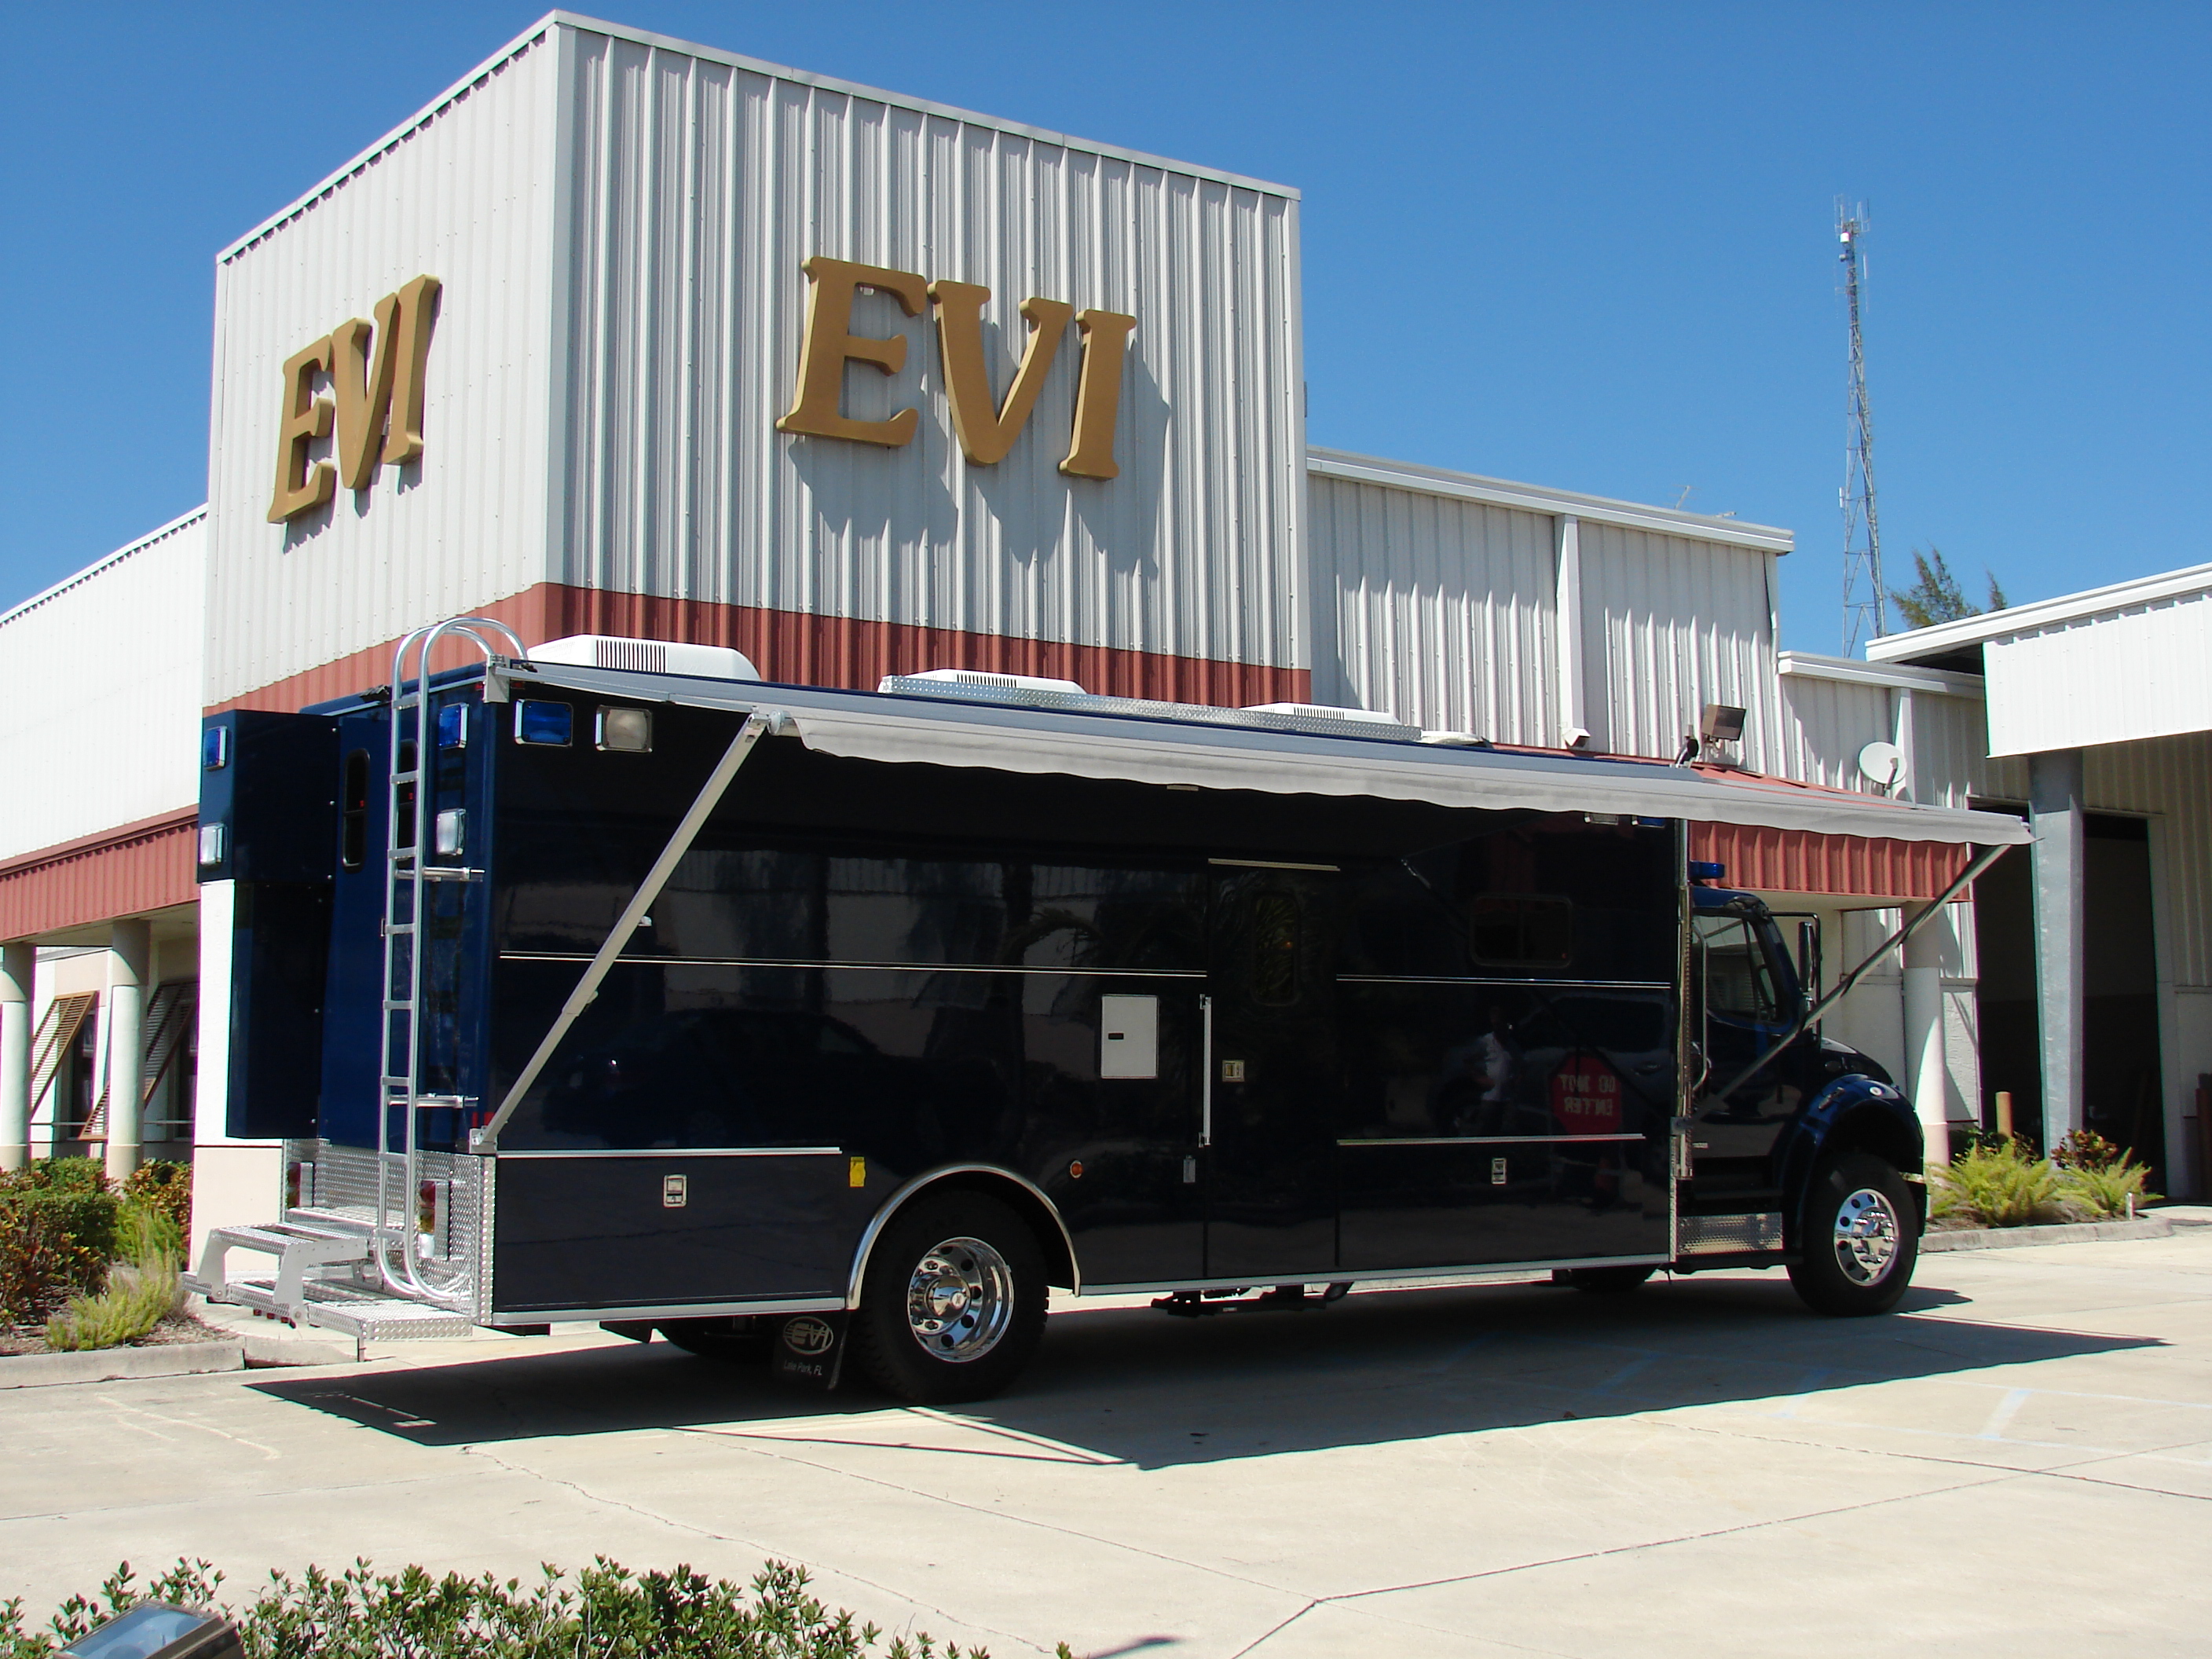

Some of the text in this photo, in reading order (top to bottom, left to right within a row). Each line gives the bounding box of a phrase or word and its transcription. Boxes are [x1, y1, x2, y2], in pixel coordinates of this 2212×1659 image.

[267, 274, 441, 525] EVI
[775, 256, 1137, 482] EVI
[790, 1322, 831, 1350] EVI
